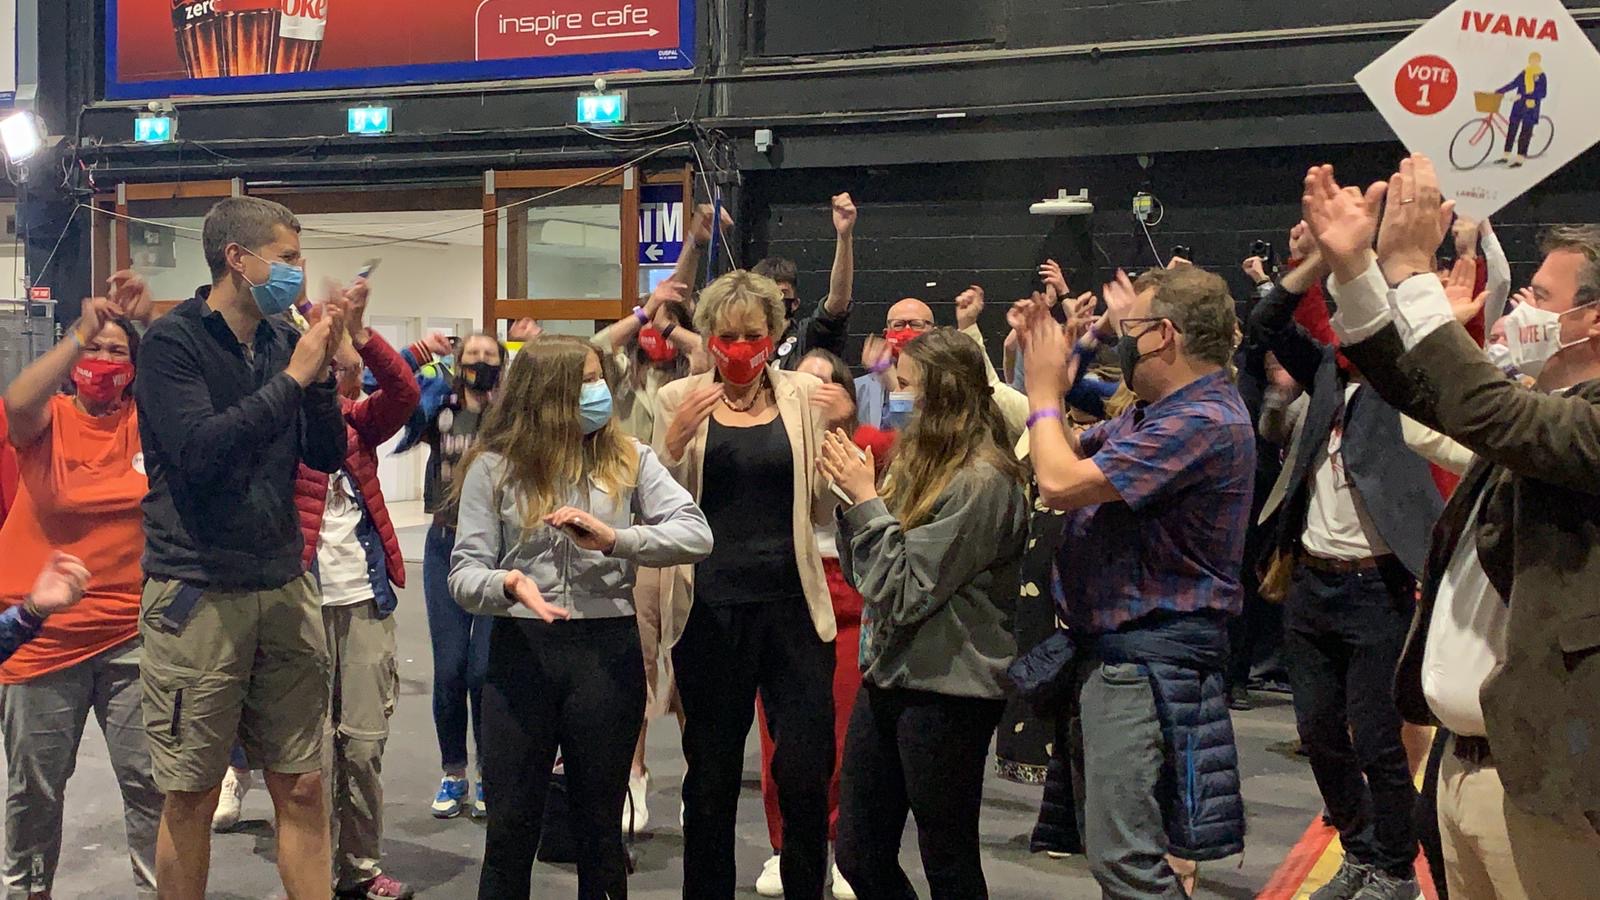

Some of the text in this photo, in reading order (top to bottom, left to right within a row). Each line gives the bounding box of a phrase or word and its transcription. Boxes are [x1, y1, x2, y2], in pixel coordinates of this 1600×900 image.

[499, 4, 648, 36] inspire cafe
[1461, 10, 1559, 41] IVANA
[1407, 64, 1451, 84] VOTE
[1416, 84, 1431, 107] 1
[639, 202, 683, 242] TM
